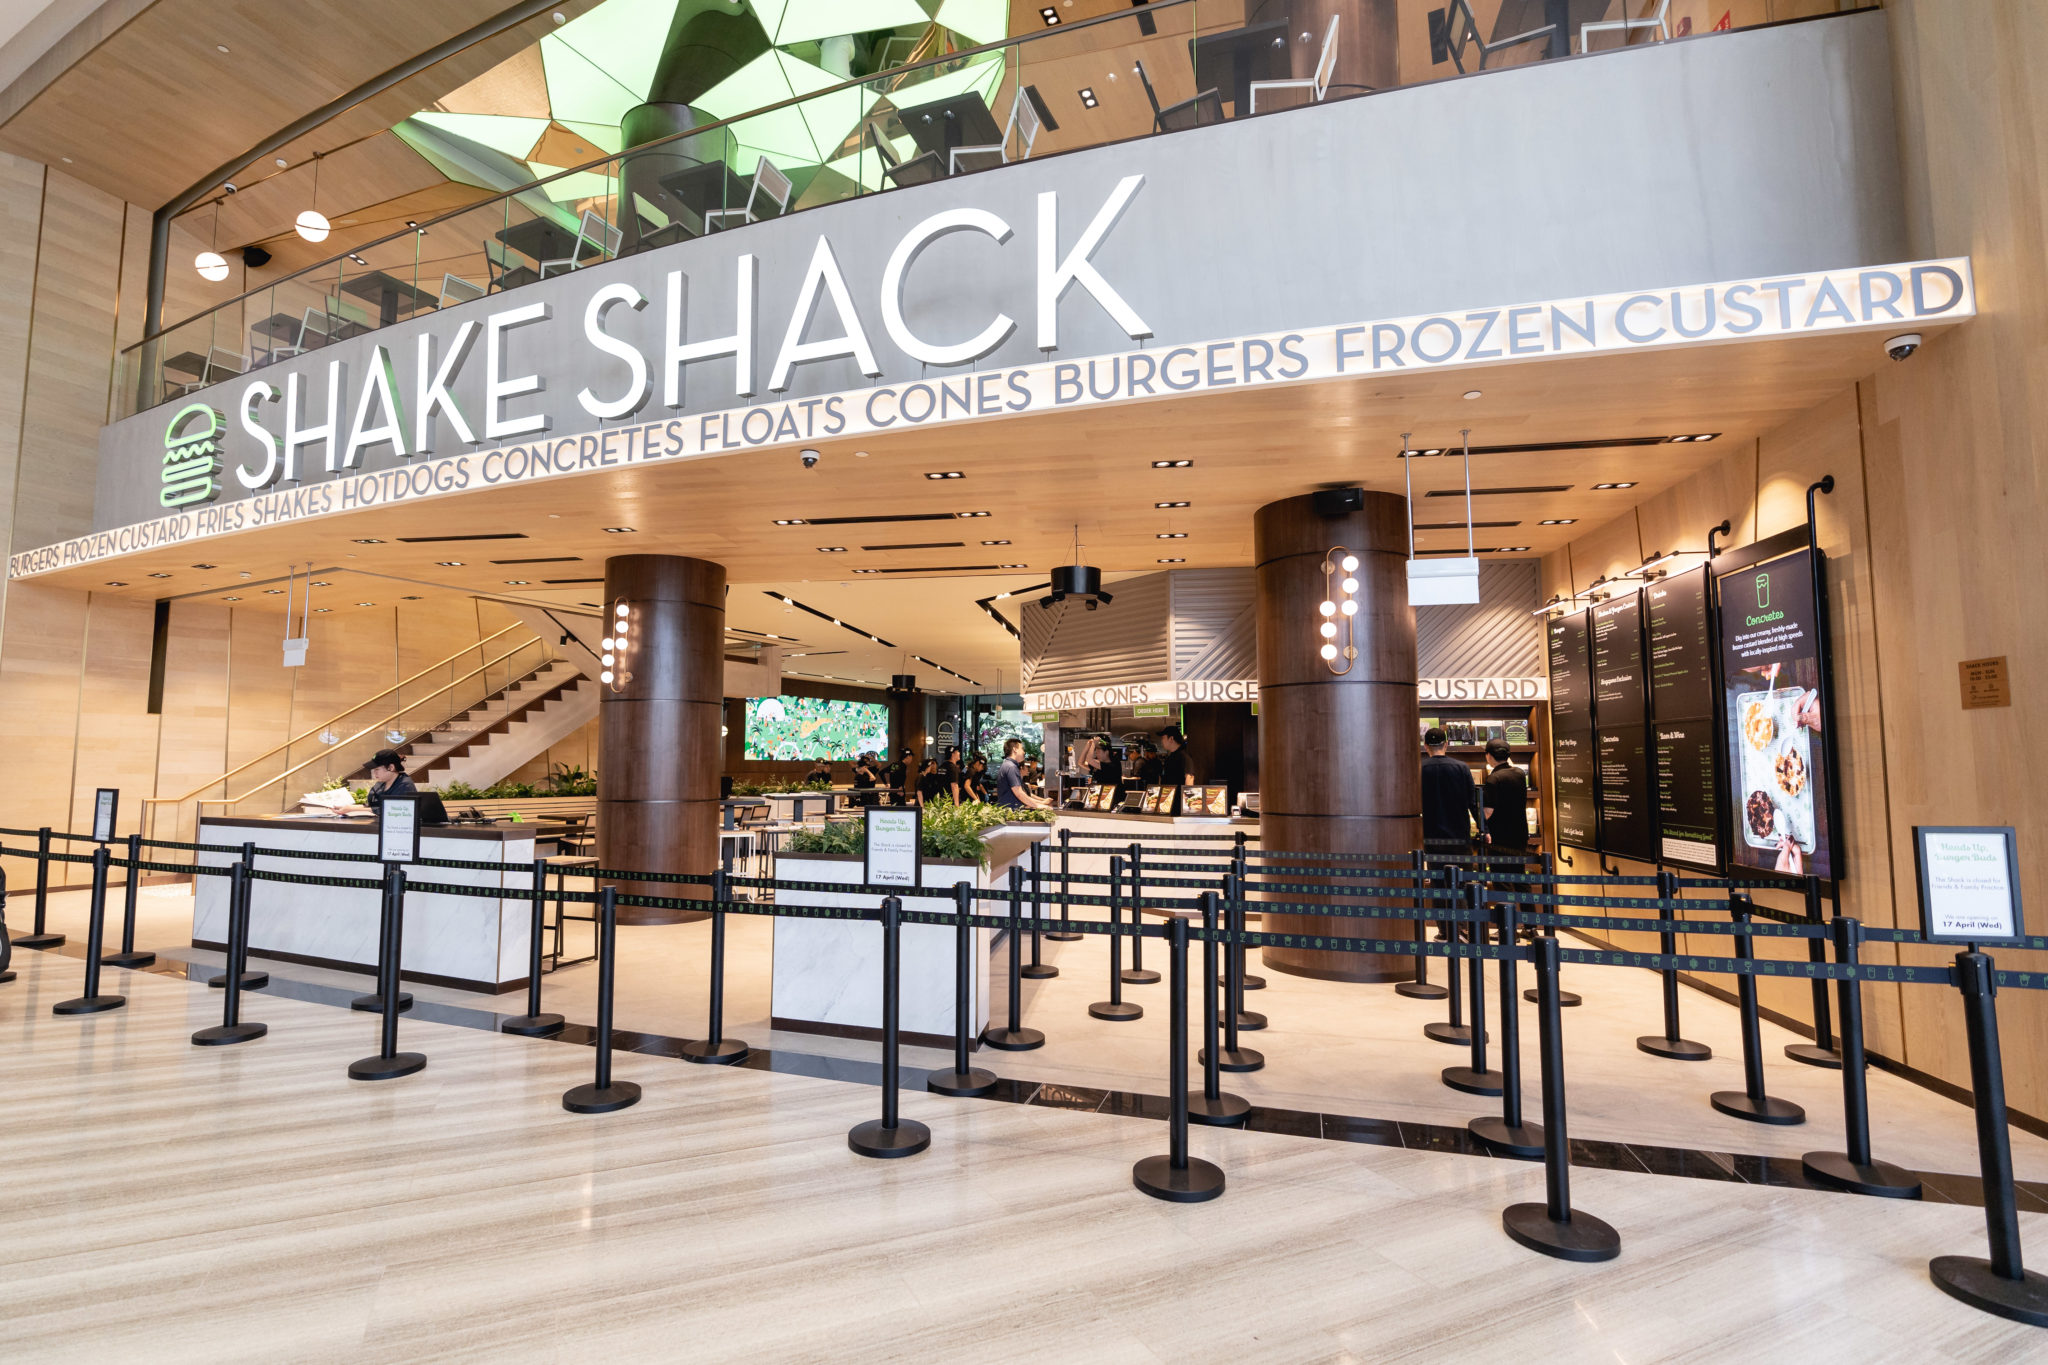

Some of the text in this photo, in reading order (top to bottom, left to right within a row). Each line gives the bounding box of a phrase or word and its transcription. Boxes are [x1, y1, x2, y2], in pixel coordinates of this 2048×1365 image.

[235, 173, 1154, 490] SHAKE SHACK
[10, 265, 1964, 579] BURGERS FROZEN CUSTARD FRIES SHAKES HOTDOGS CONCRETES FLOATS CONES BURGERS FROZEN CUSTARD
[1746, 610, 1784, 626] Concretes
[1037, 685, 1148, 710] FLOATS CONES
[1175, 681, 1258, 701] BURGE
[1418, 679, 1538, 700] CUSTARD
[1941, 843, 1971, 852] Hands
[1955, 921, 1975, 929] April
[1977, 921, 2002, 930] (Wed)
